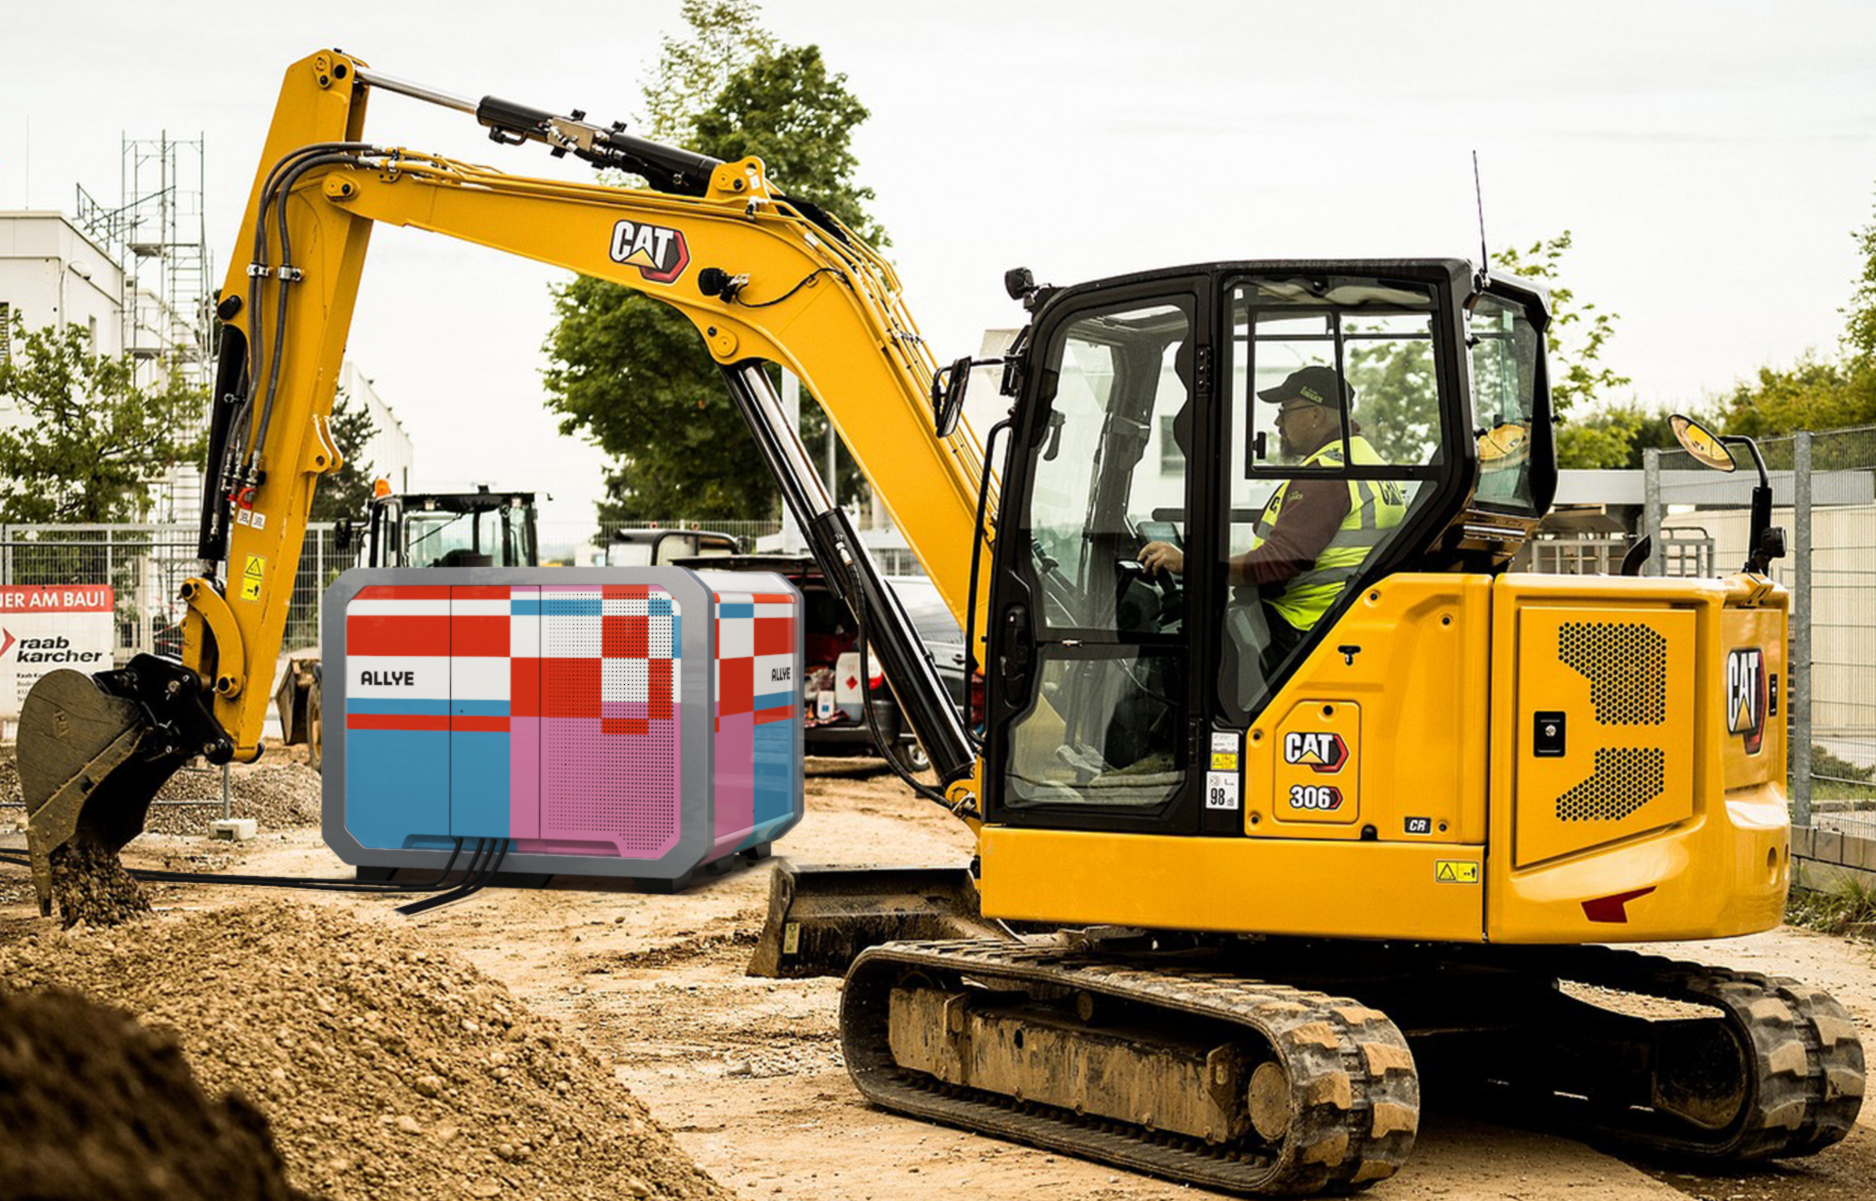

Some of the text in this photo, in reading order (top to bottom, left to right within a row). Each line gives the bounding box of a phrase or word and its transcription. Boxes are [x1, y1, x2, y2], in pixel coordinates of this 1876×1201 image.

[610, 220, 675, 270] CAT
[29, 592, 60, 607] AM
[63, 591, 106, 607] BAU!
[19, 636, 70, 649] raab
[17, 650, 102, 663] karcher
[361, 670, 414, 686] ALLYE
[771, 667, 791, 681] ALLYE
[1727, 651, 1760, 732] CAT
[1285, 732, 1333, 764] CAT
[1210, 787, 1226, 806] 98
[1290, 786, 1331, 808] 306
[1409, 819, 1427, 831] CR
